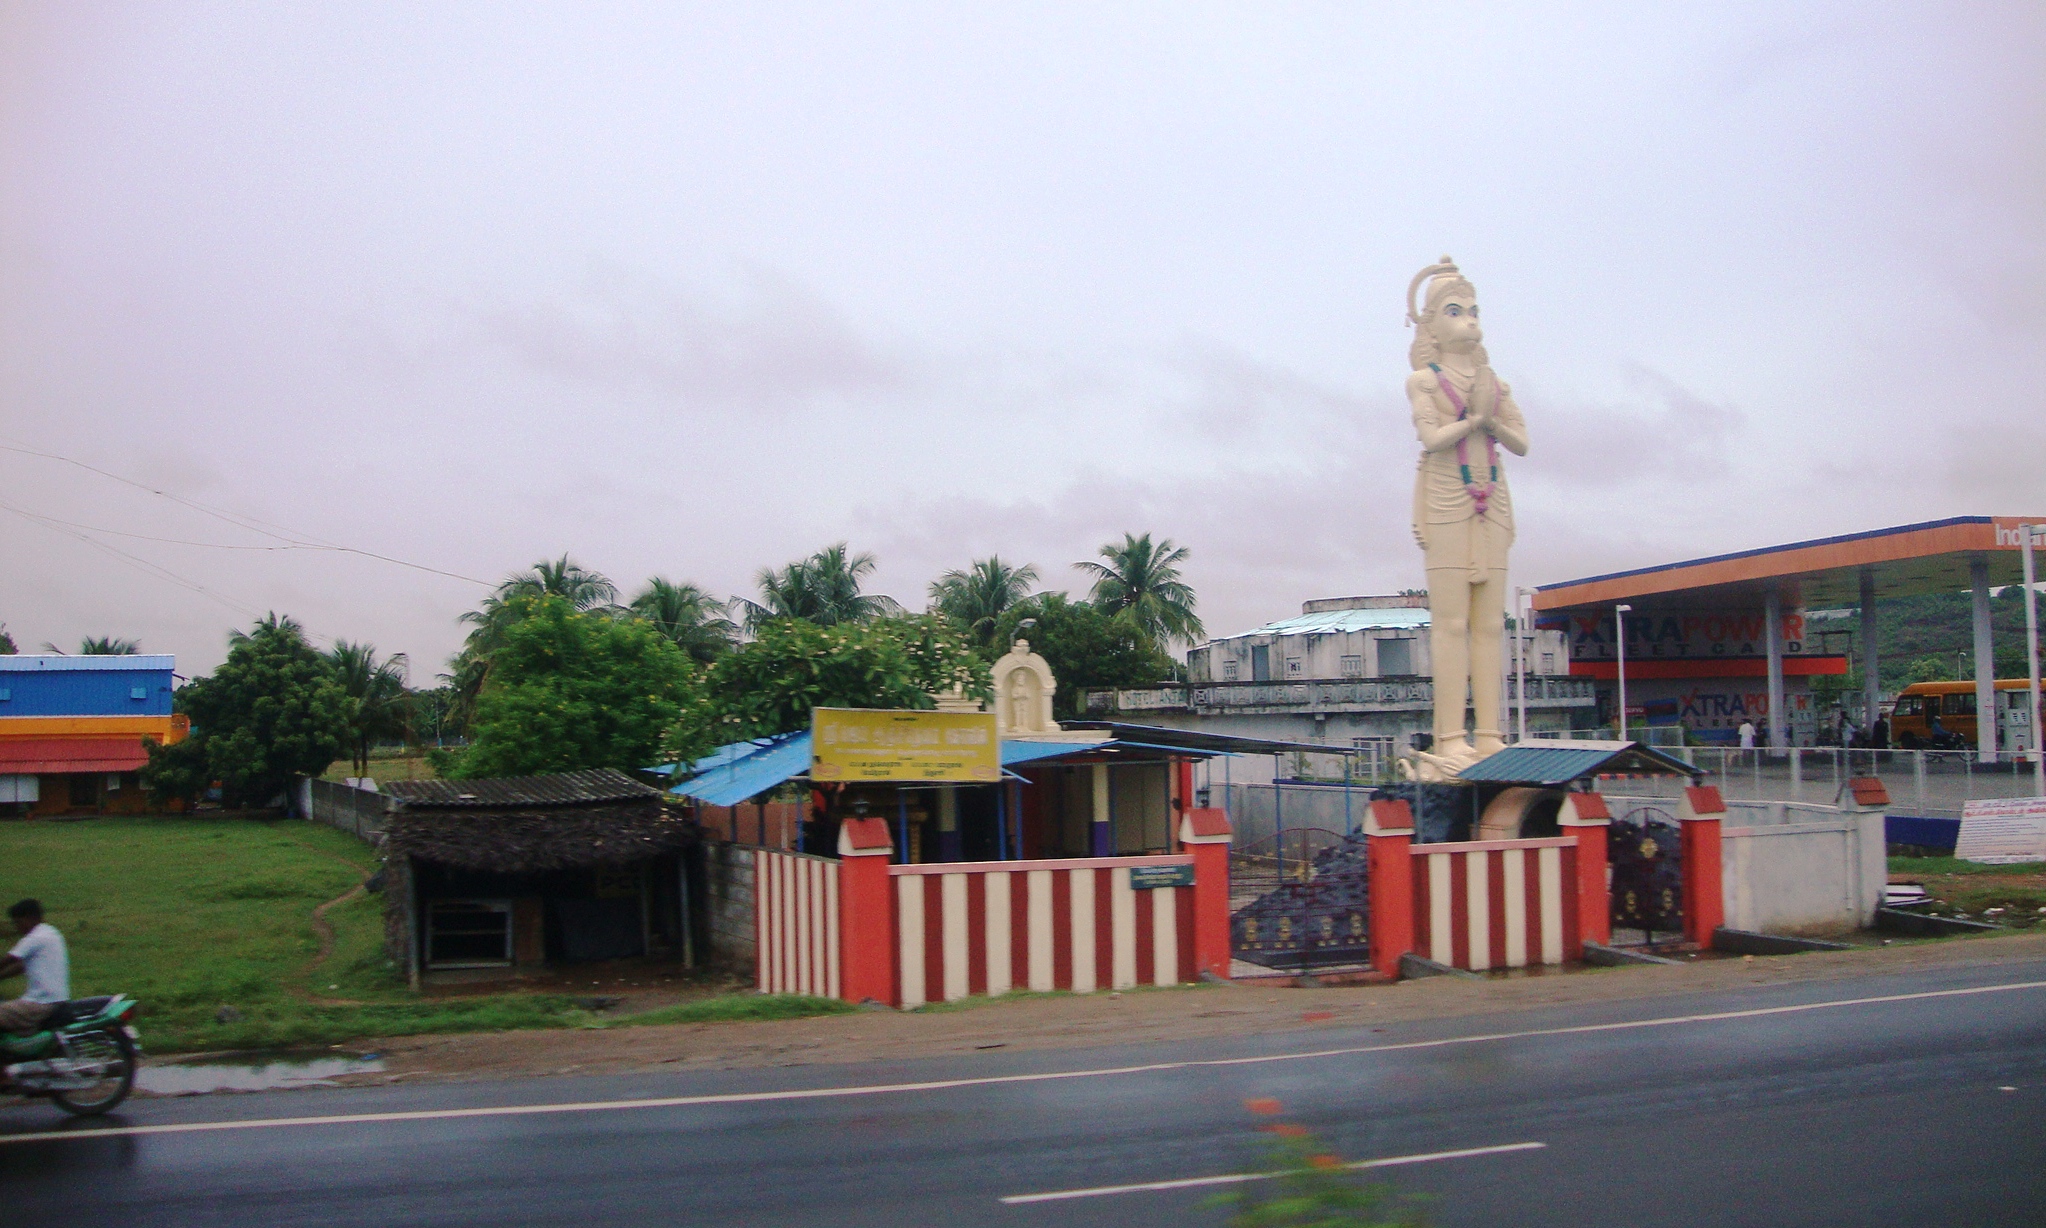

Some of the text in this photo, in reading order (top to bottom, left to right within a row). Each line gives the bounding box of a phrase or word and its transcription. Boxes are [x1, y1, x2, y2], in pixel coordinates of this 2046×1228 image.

[1574, 610, 1803, 643] XTRAPOWR
[1574, 641, 1802, 657] FLEET CAD
